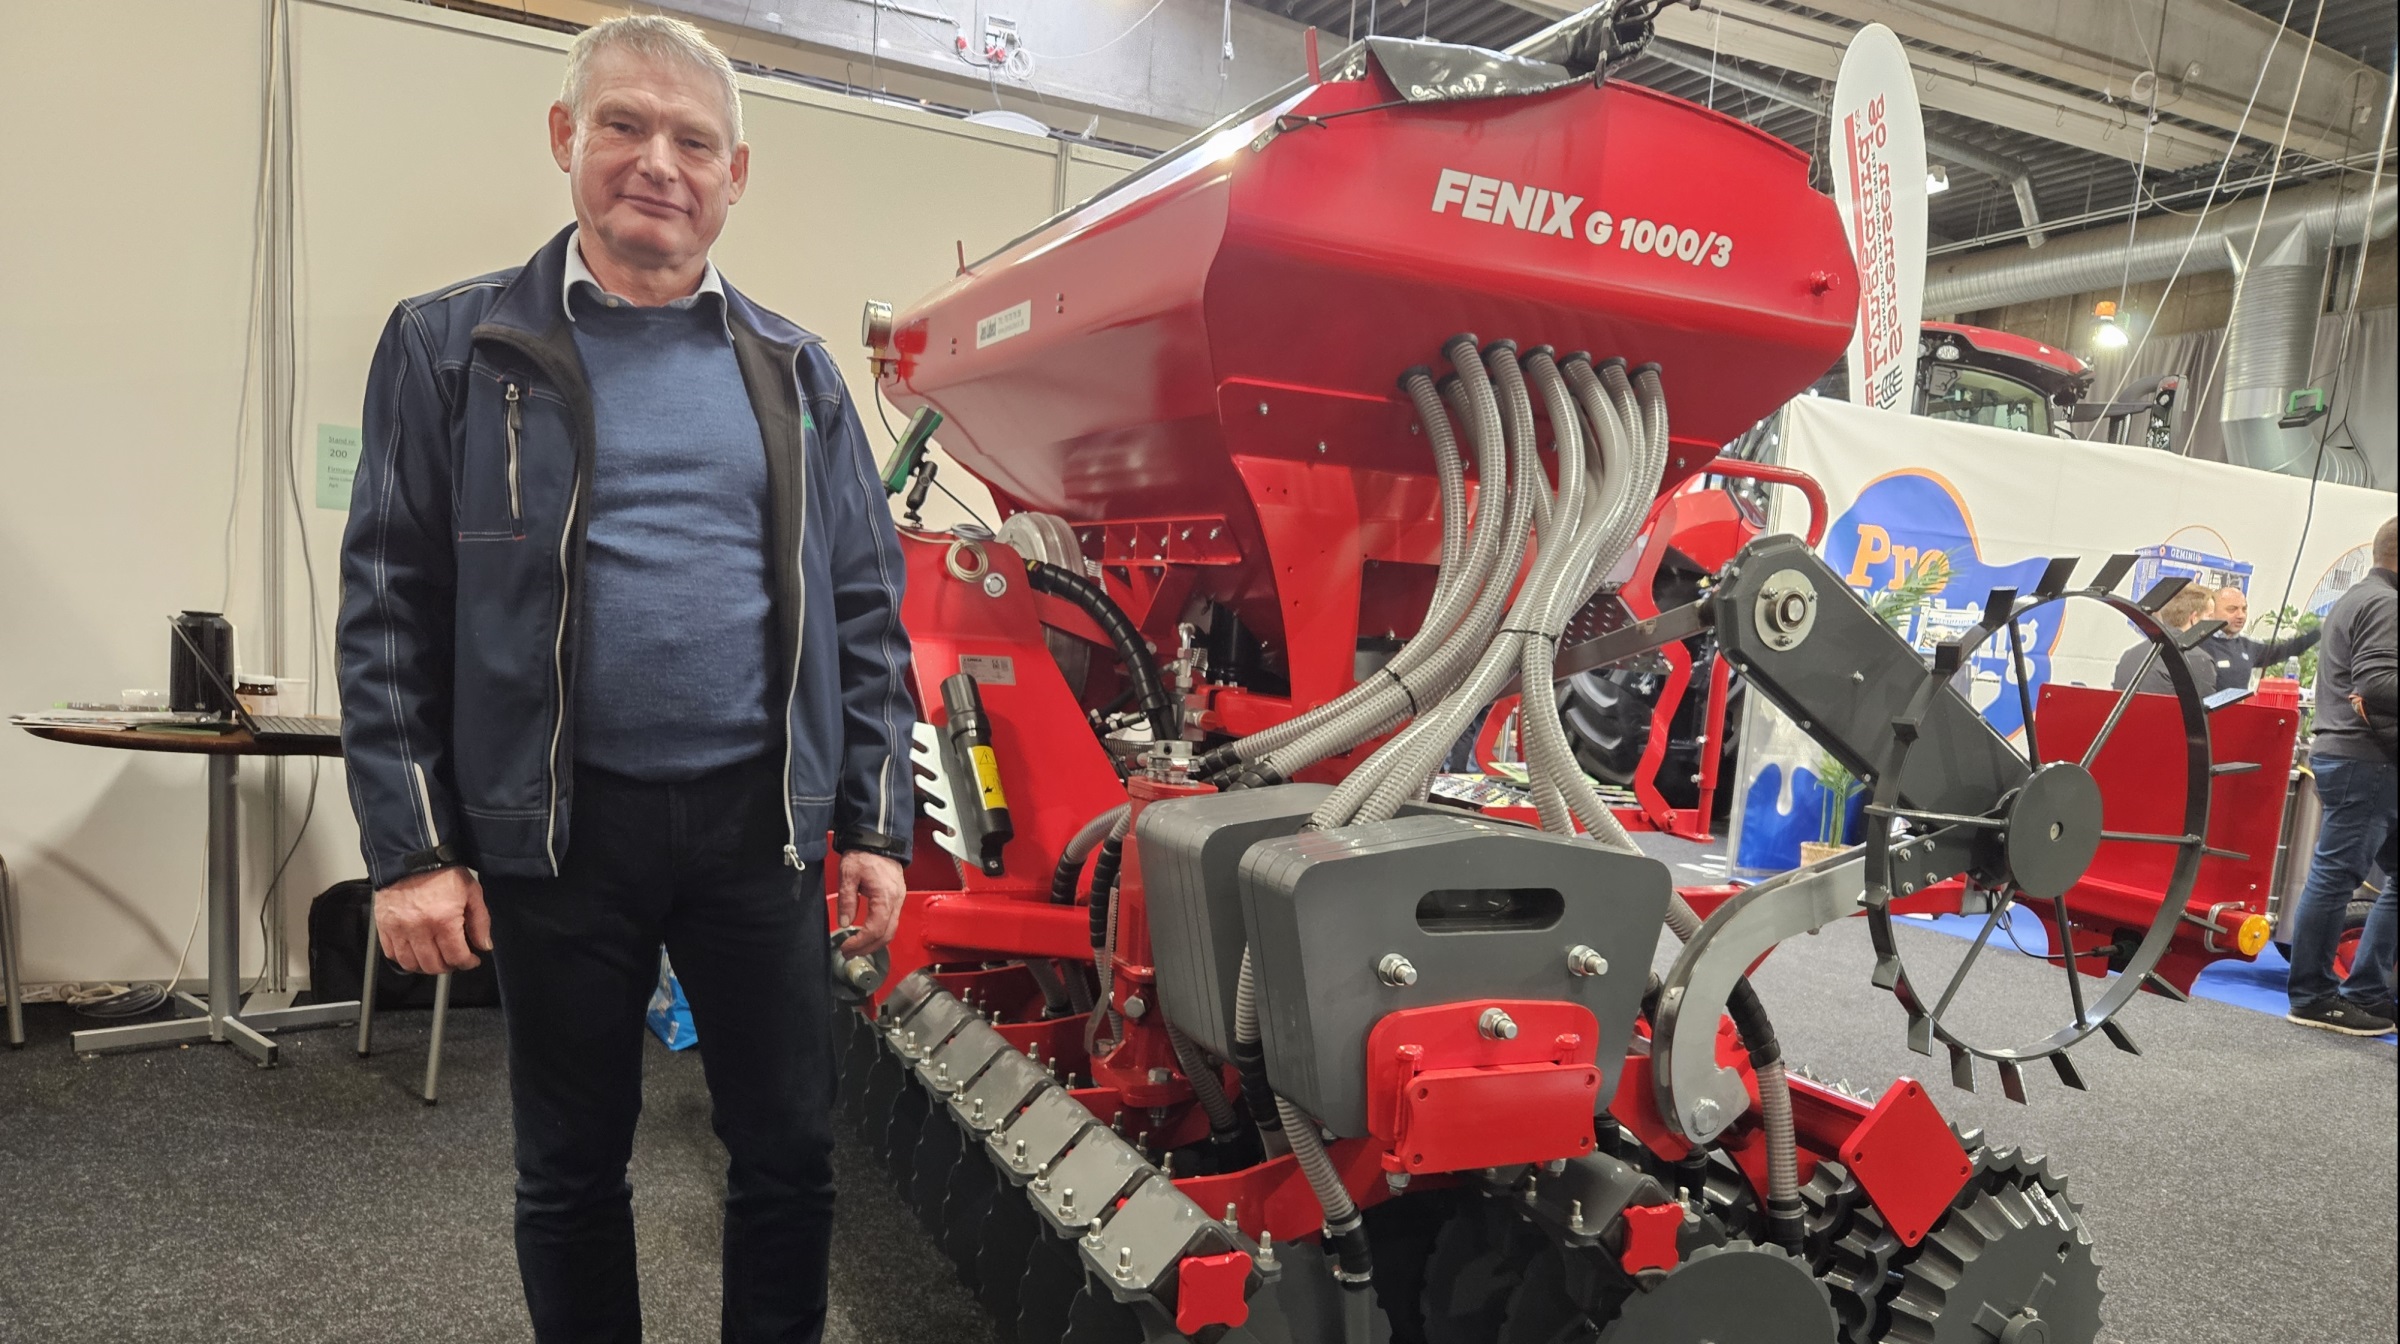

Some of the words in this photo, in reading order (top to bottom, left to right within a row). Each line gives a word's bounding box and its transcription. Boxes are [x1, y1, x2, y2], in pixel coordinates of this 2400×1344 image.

[1431, 168, 1584, 239] FENIX
[1585, 210, 1614, 245] G
[1619, 217, 1733, 268] 1000/3
[329, 449, 348, 458] 200
[1845, 524, 1949, 595] Pro
